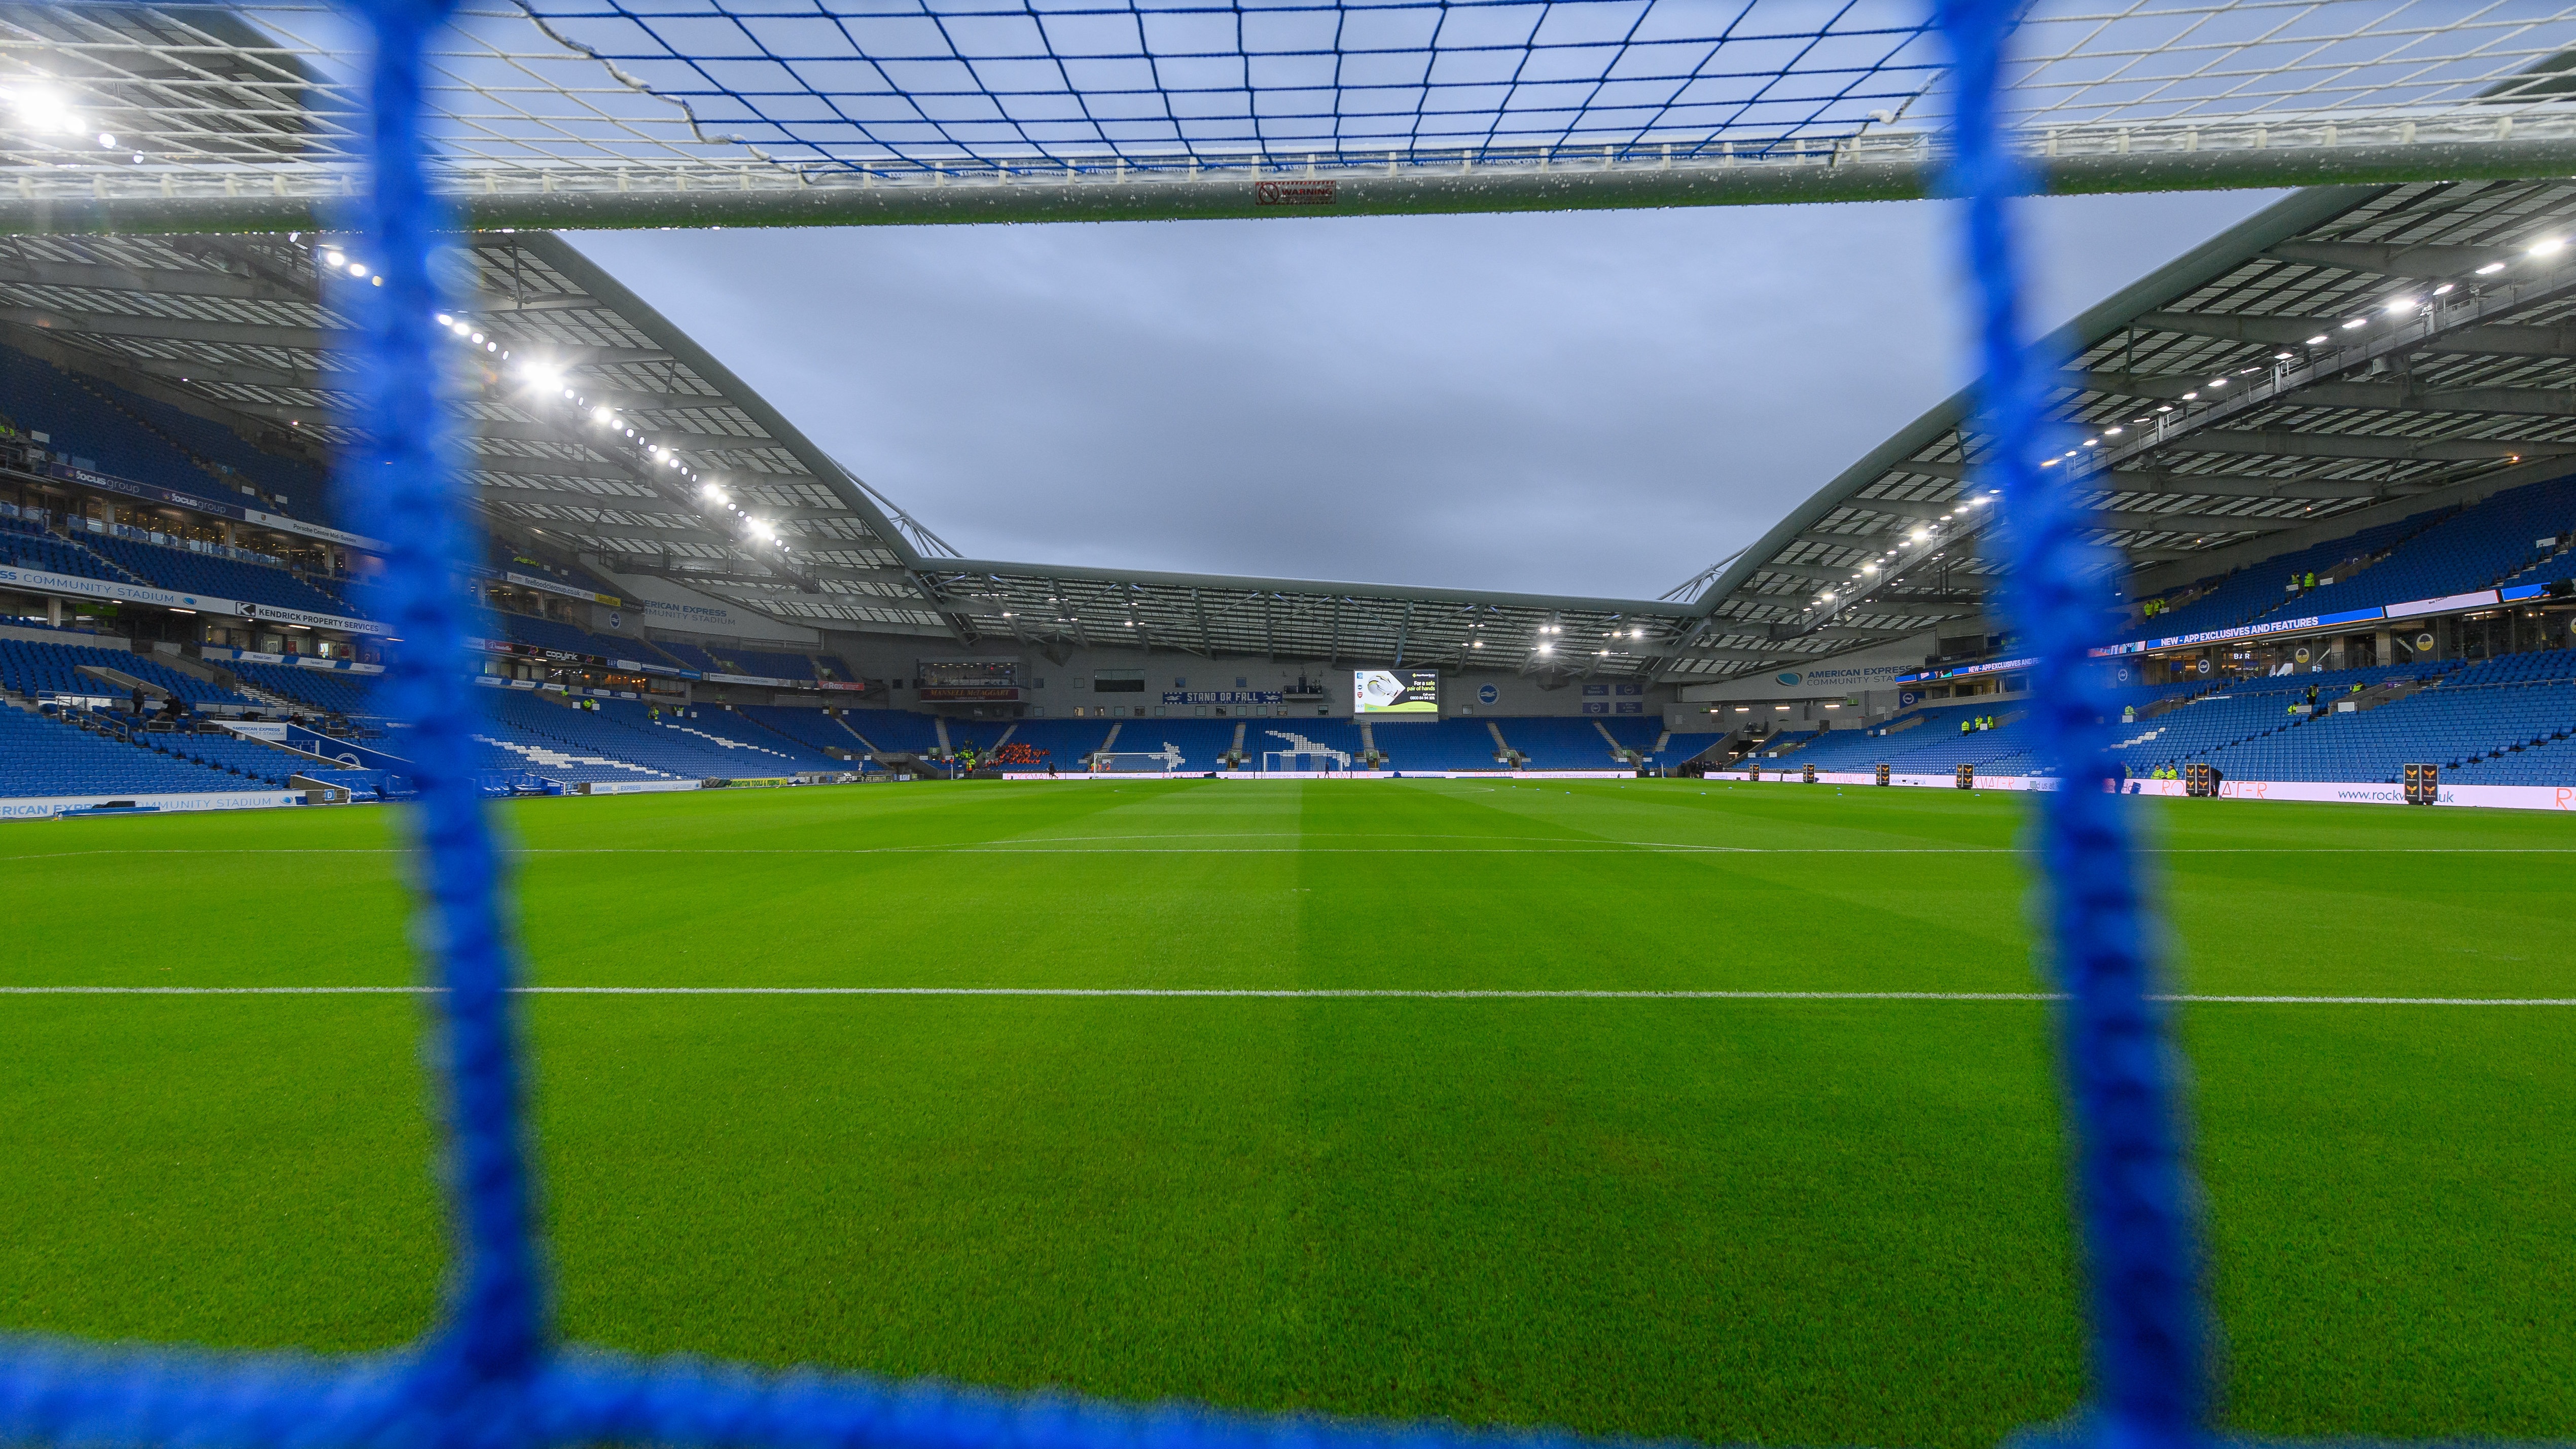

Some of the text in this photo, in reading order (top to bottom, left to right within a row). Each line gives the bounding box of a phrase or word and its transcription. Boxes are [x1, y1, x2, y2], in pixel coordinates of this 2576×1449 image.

[293, 523, 356, 543] Porsche Centre Mid-Sussex
[23, 573, 111, 594] COMMUNITY
[117, 587, 174, 603] STADIUM
[525, 577, 580, 596] firefloodcleanup.co.uk
[645, 600, 679, 611] ERICAN
[683, 605, 727, 617] EXPRESS
[645, 608, 735, 625] MUNITY STADIUM
[259, 608, 379, 632] KENDRICK PROPERTY SERVICES
[2161, 636, 2178, 646] NEW
[2184, 633, 2199, 644] APP
[2200, 627, 2250, 641] EXCLUSIVES
[2251, 623, 2270, 634] AND
[2271, 616, 2318, 632] FEATURES
[546, 650, 578, 660] copylink
[1808, 665, 1912, 678] AMERICAN EXPRESS
[1992, 660, 2021, 669] EXCLUSIVES
[1807, 677, 1869, 686] COMMUNITY
[1187, 692, 1259, 701] STAND OR FALL
[1827, 773, 1866, 784] ROCKWATER
[2162, 781, 2267, 800] ROATER
[135, 799, 210, 809] OMMUNITY
[217, 798, 271, 807] STADIUM
